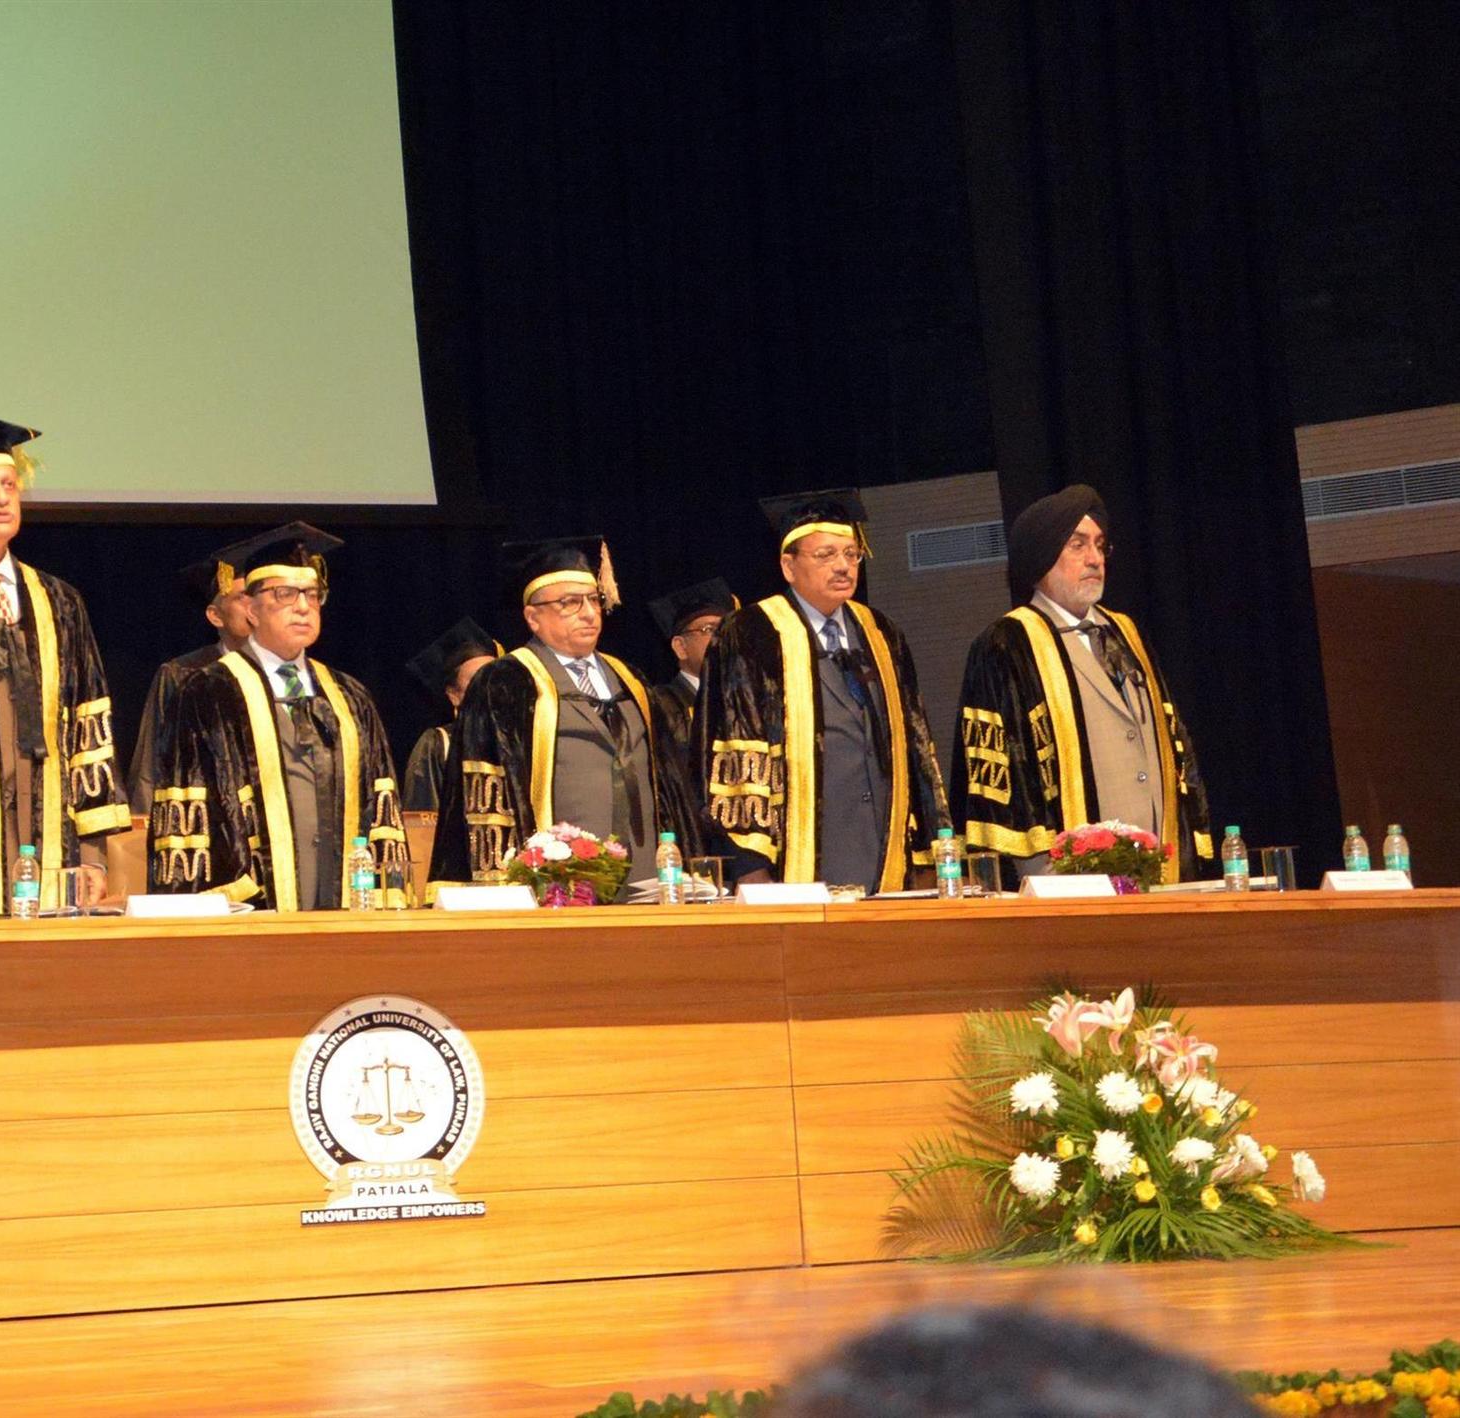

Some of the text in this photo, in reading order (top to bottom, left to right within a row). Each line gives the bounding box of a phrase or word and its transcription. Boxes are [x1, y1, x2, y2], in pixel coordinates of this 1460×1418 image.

[318, 1016, 370, 1060] NATIONAL
[372, 1013, 443, 1043] UNIVERSITY
[439, 1042, 456, 1059] OF
[308, 1059, 325, 1110] GANDHI
[310, 1112, 335, 1149] RAJIV
[445, 1093, 467, 1143] PUNJAB
[347, 1161, 437, 1180] RGNUL
[357, 1184, 430, 1197] PATIALA
[302, 1202, 486, 1225] KNOWLEDGE EMPOWERS
